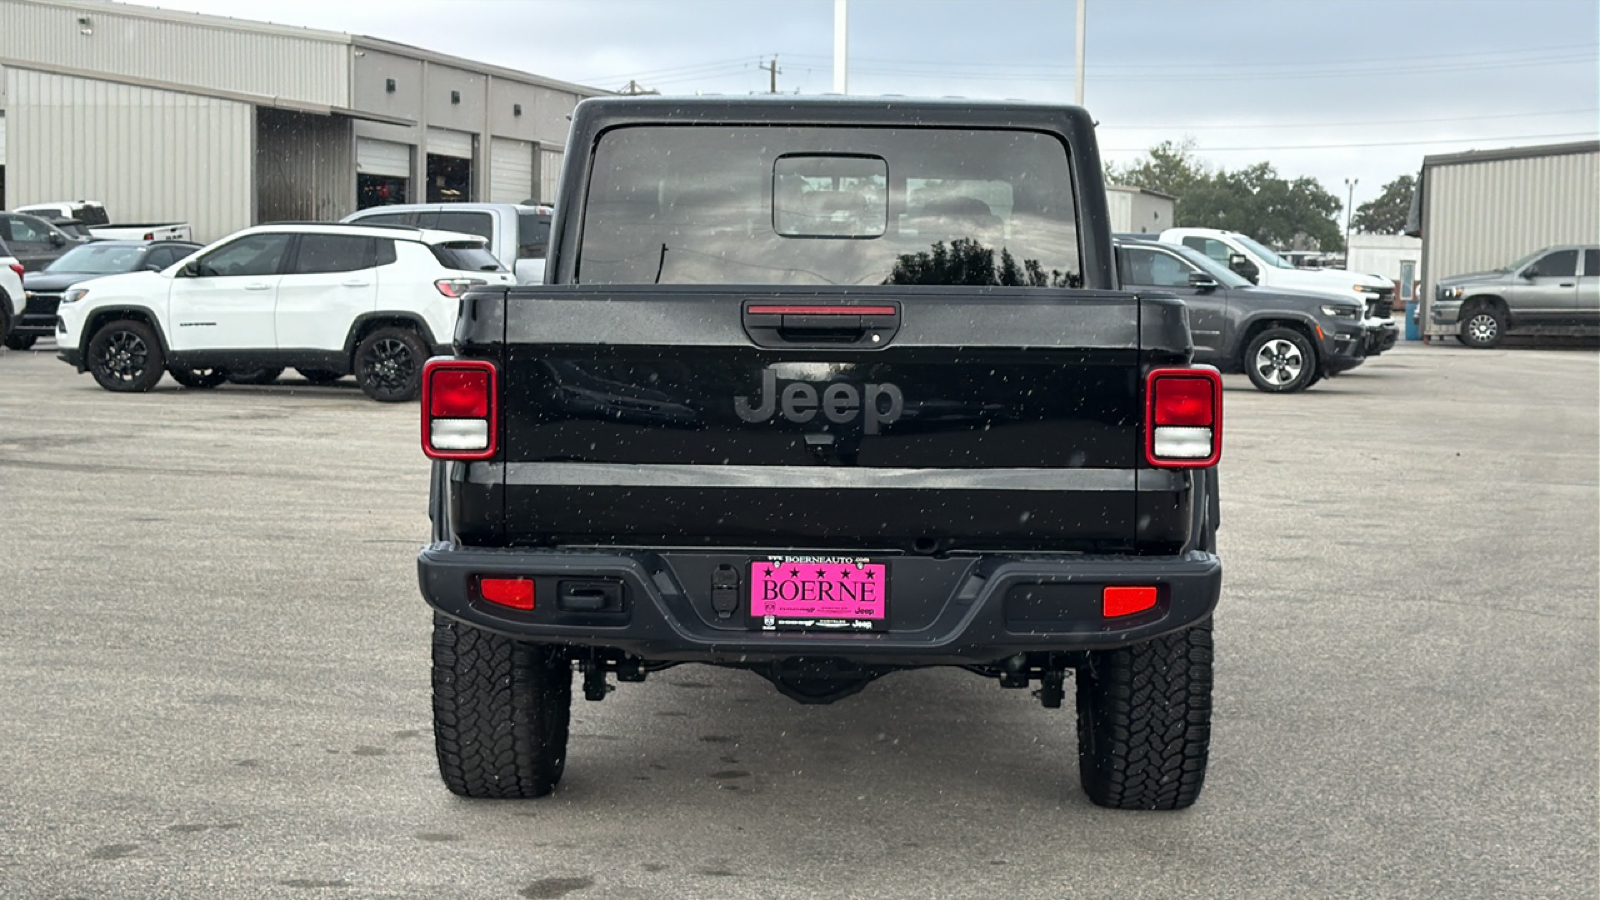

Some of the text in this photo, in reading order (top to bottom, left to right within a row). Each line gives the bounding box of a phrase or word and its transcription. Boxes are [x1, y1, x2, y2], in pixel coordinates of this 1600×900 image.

[734, 369, 904, 435] Jeep
[785, 556, 853, 564] BOERNEAUTO
[762, 580, 876, 601] BOERNE
[855, 607, 875, 615] Jeep
[852, 620, 872, 629] Jeep
